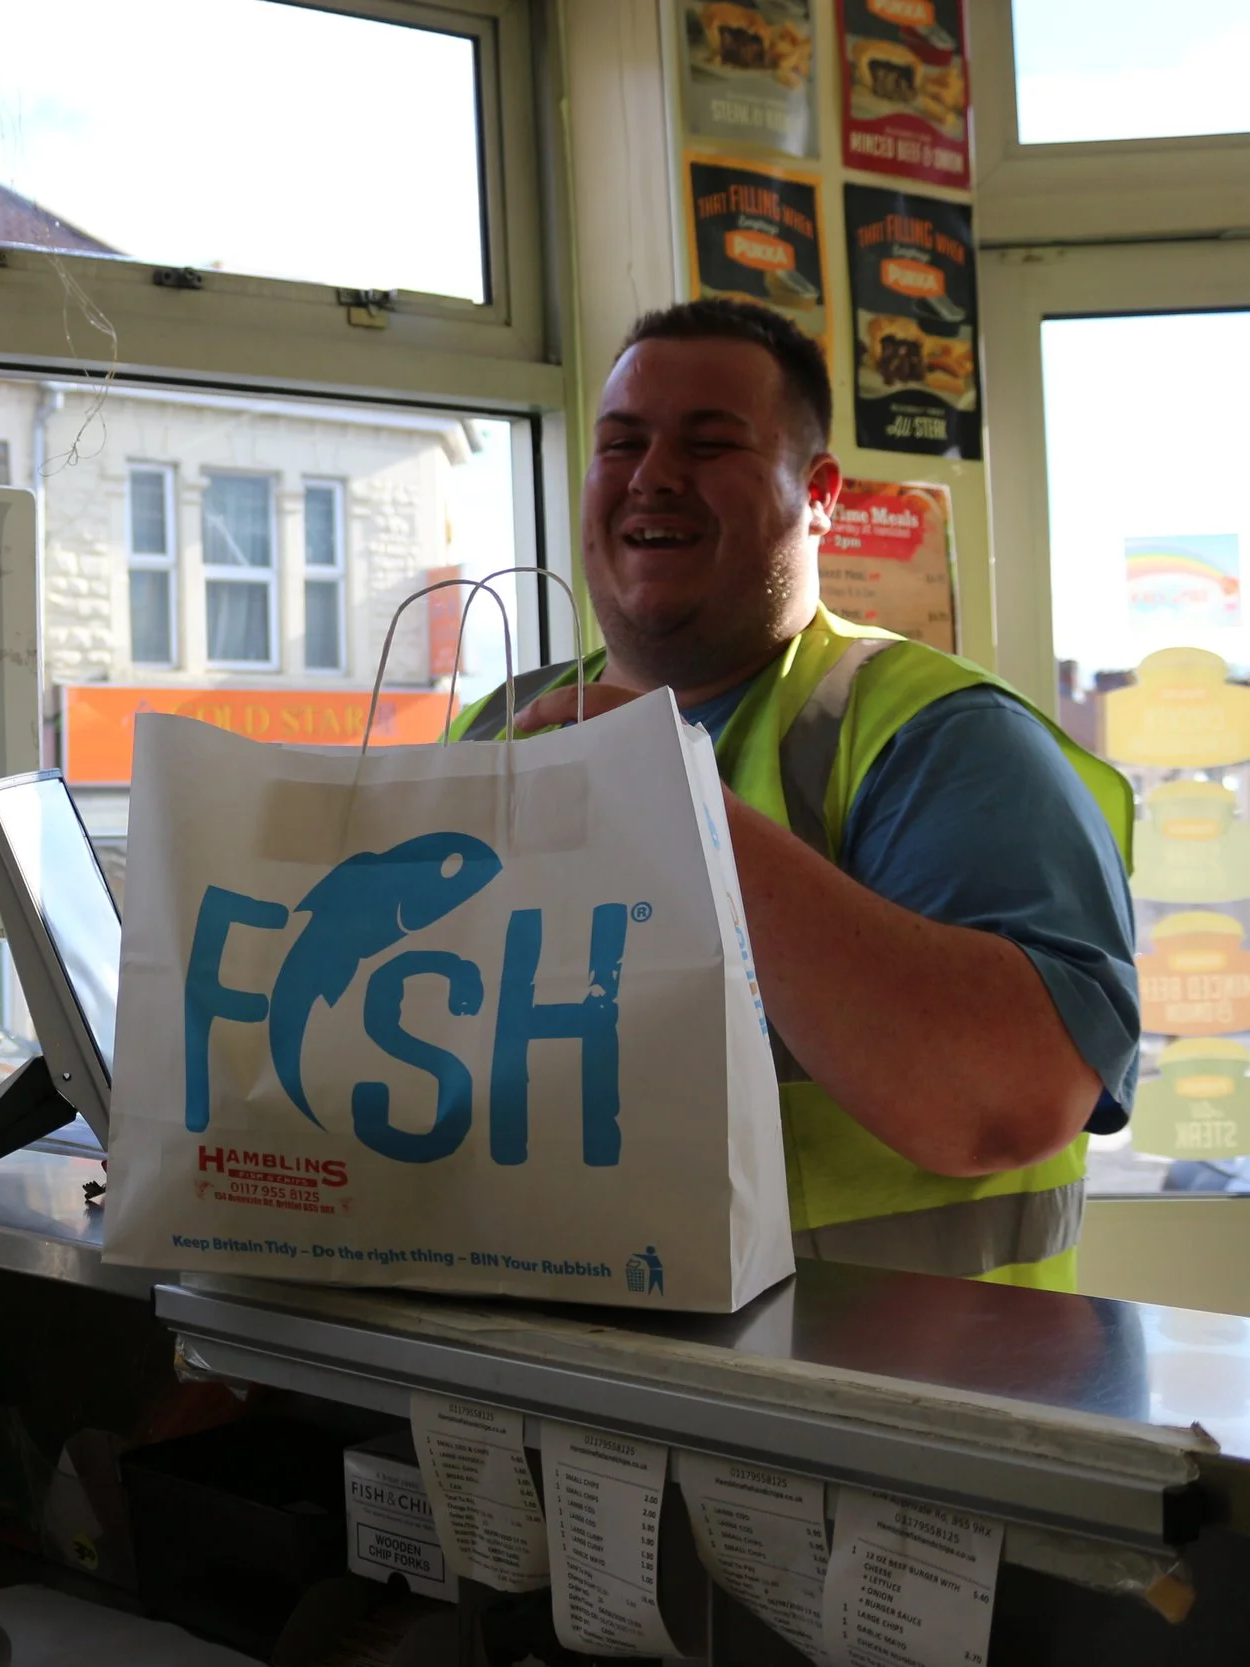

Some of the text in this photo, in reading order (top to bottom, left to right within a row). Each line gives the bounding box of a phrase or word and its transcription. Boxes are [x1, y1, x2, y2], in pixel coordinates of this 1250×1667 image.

[850, 131, 894, 160] MINCED
[698, 193, 727, 219] THAT
[729, 184, 781, 222] FILLING
[782, 205, 815, 240] WHEN
[733, 235, 788, 264] PUKKA
[858, 220, 886, 248] THAT
[886, 214, 933, 249] FILLING
[937, 231, 966, 265] WHEN
[889, 263, 938, 290] PUKKA
[912, 416, 948, 441] STEAK
[870, 505, 919, 528] Meals
[198, 1145, 349, 1188] HAMBLINS
[230, 1182, 320, 1202] 0117 955 8125
[172, 1234, 612, 1279] Keep Britain Tidy Do the right thing BIN Your Rubbish
[565, 1472, 582, 1485] SMALL
[583, 1479, 599, 1490] CHIPS
[730, 1467, 788, 1488] 01179558125
[351, 1481, 384, 1503] FISH
[386, 1491, 396, 1506] &
[894, 1513, 959, 1544] 01179558125
[375, 1533, 422, 1557] WOODEN
[368, 1544, 430, 1573] CHIP FORKS
[863, 1562, 892, 1578] CHEESE
[865, 1551, 874, 1561] 12
[888, 1560, 907, 1571] BEEF
[909, 1564, 939, 1584] BURGER
[940, 1577, 961, 1593] WITH
[869, 1575, 903, 1593] LETTUCE
[867, 1587, 894, 1603] ONION
[857, 1610, 880, 1625] LARGE
[882, 1619, 904, 1635] CHIPS
[864, 1598, 922, 1626] BURGER SAUCE
[857, 1624, 882, 1641] GARLIC
[884, 1635, 907, 1650] MAYO
[857, 1637, 889, 1656] CHICKEN
